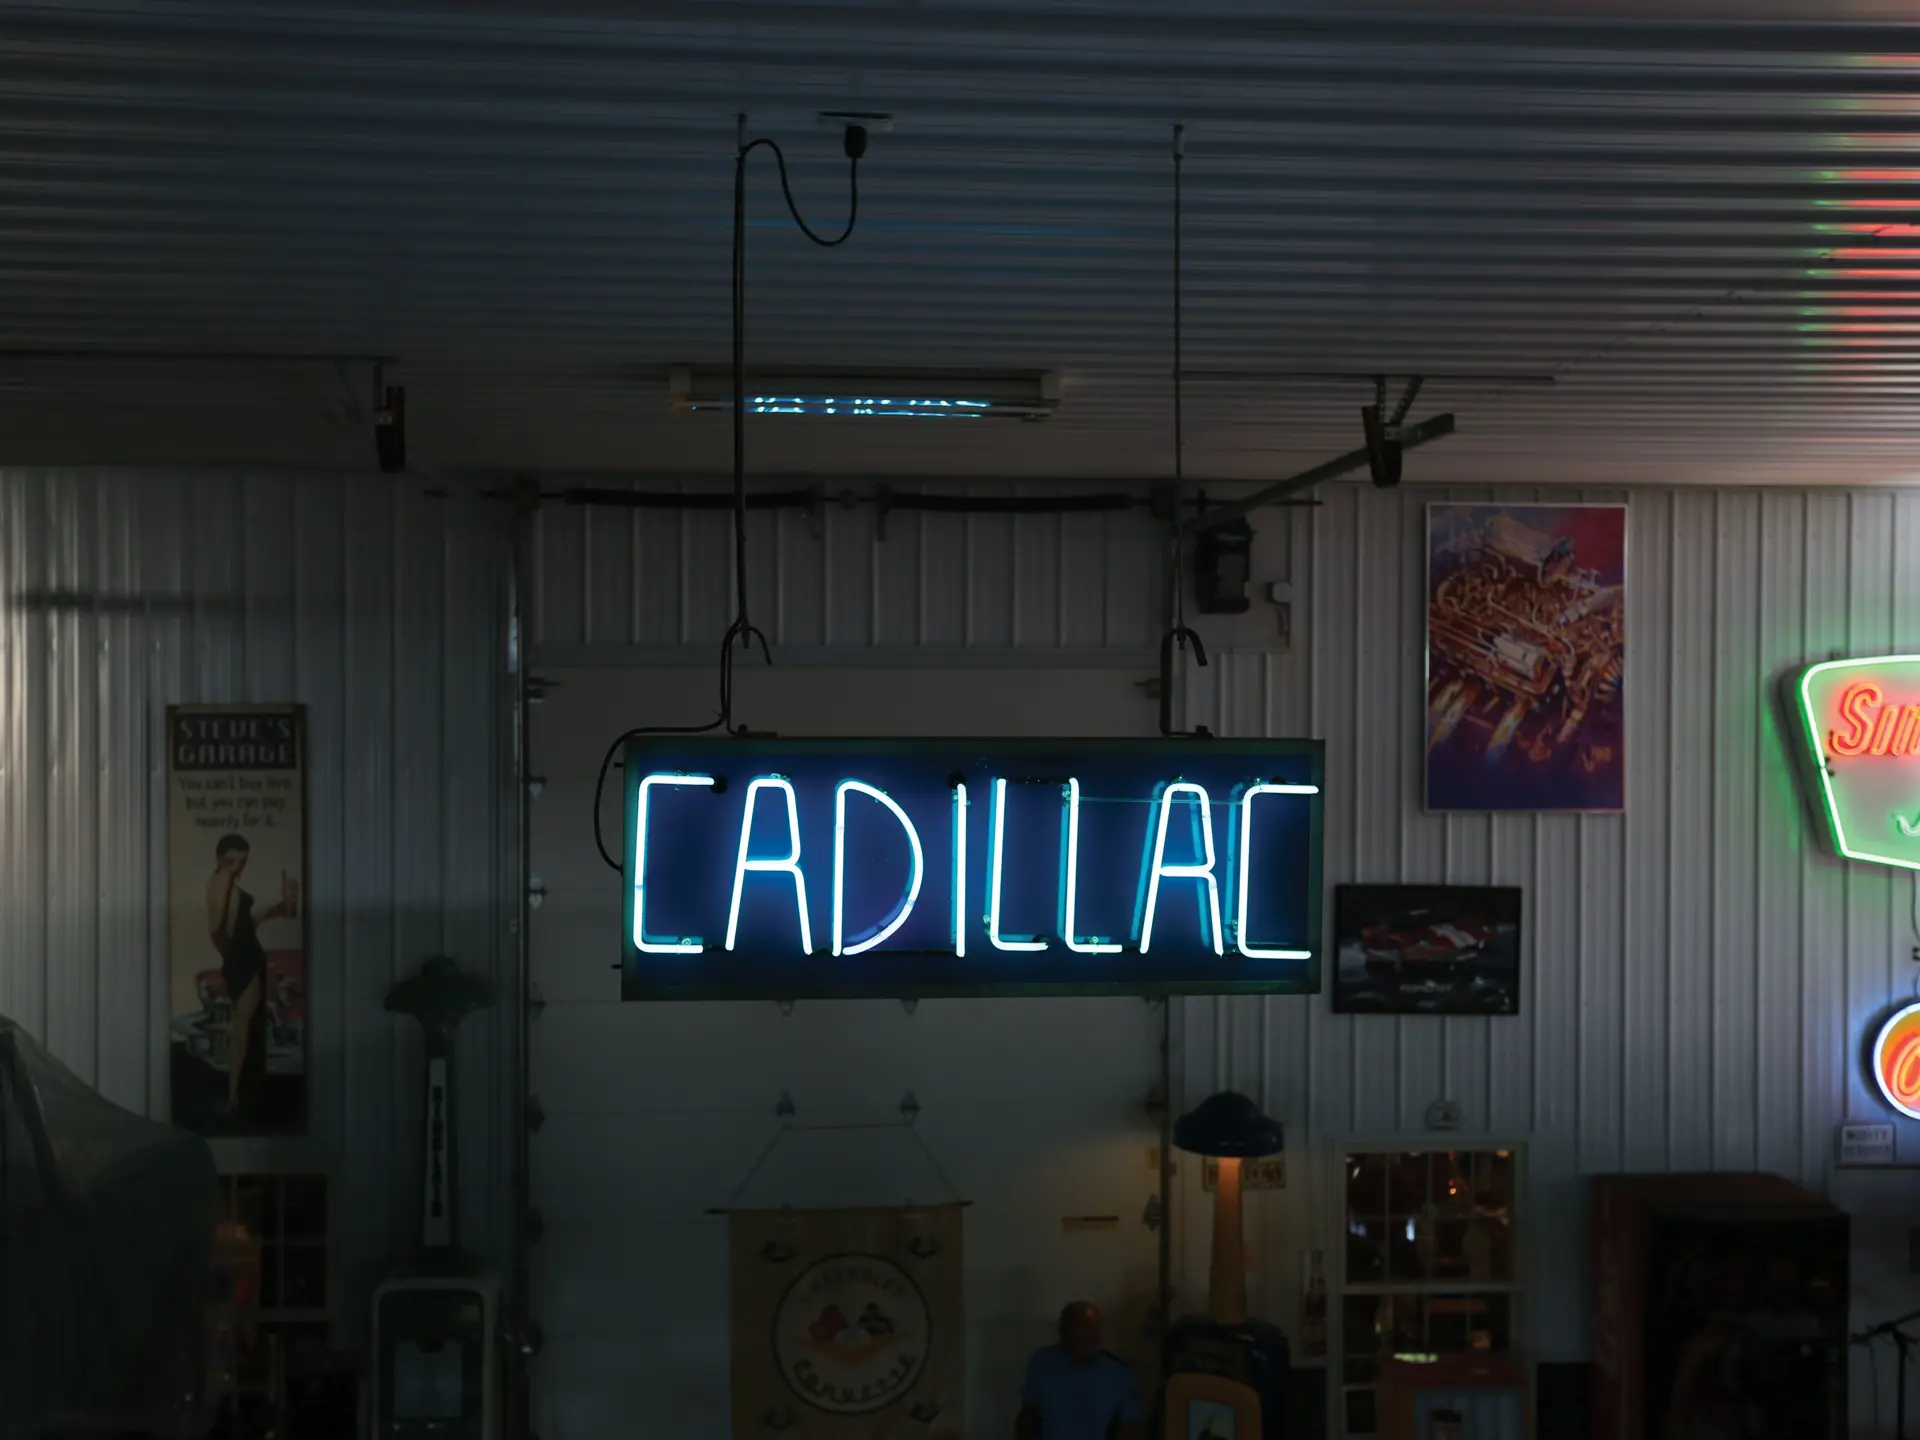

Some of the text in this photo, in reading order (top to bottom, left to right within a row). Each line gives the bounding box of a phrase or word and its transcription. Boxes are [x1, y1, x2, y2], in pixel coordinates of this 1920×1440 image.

[180, 718, 292, 739] STEVE'S
[179, 743, 292, 765] GARAGE
[633, 776, 1320, 958] CADILLAC
